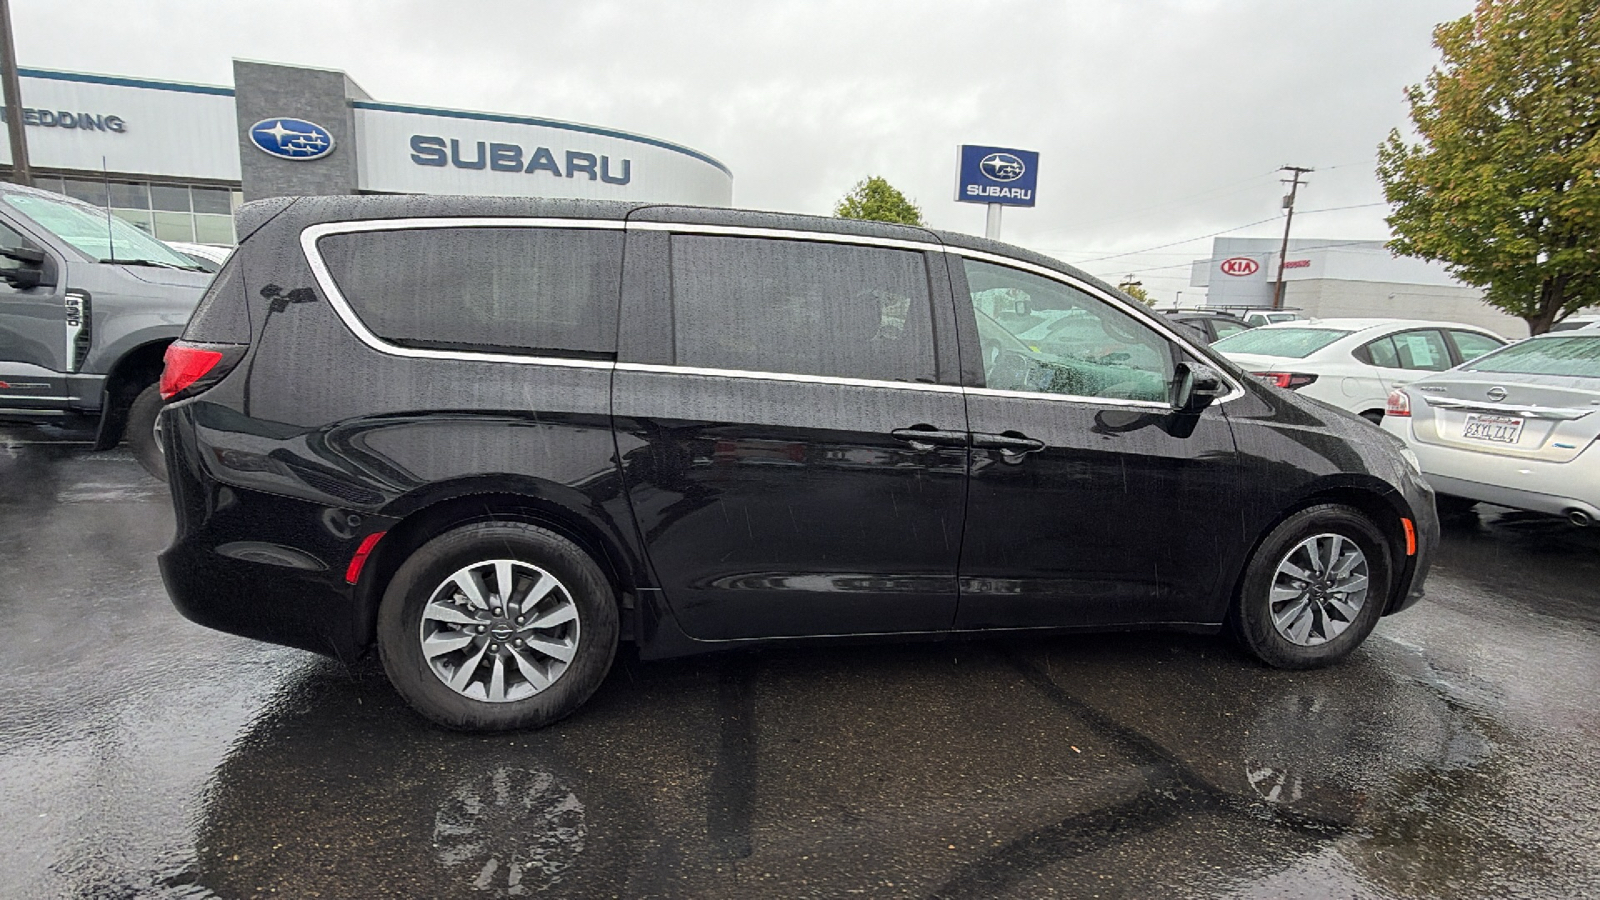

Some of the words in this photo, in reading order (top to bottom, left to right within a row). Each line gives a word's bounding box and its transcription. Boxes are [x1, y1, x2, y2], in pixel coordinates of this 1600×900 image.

[410, 134, 631, 185] SUBARU
[966, 184, 1032, 200] SUBARU
[1227, 261, 1252, 273] KIA
